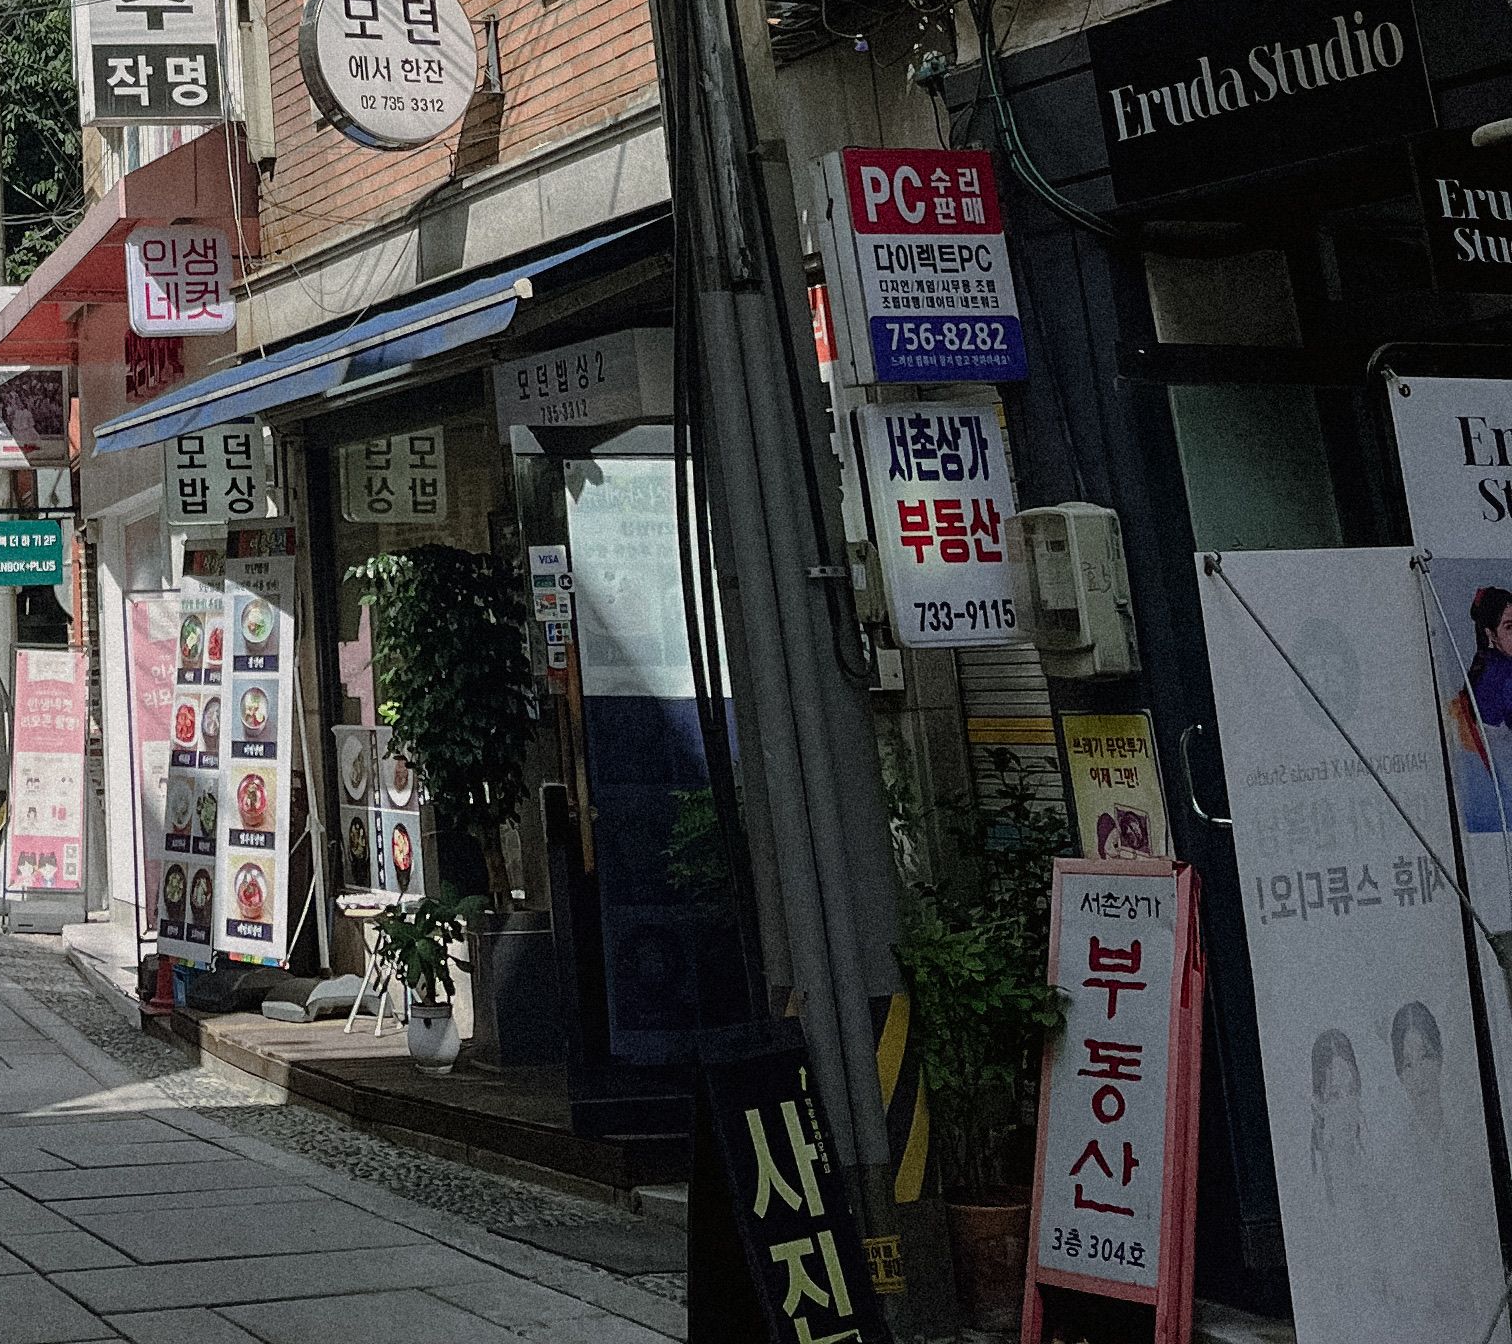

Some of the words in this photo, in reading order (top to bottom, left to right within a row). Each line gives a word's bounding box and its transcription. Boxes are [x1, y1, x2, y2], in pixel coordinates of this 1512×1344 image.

[106, 53, 210, 108] 작명
[348, 54, 392, 83] 에서
[400, 58, 444, 85] 한잔
[1108, 56, 1250, 142] Eruda
[1248, 10, 1405, 103] Studio
[360, 94, 377, 111] 02
[381, 95, 406, 112] 735
[410, 97, 445, 113] 3312
[861, 166, 925, 224] PC
[929, 168, 980, 194] 수리
[933, 196, 986, 226] 판매
[142, 238, 219, 279] 인생
[872, 243, 994, 275] 다이렉트PC
[144, 280, 223, 321] 네컷
[885, 322, 1008, 351] 756-8282
[176, 433, 253, 470] 모던
[887, 415, 990, 482] 서촌상가
[178, 475, 257, 515] 밥상
[896, 498, 1004, 565] 부동산
[914, 597, 1016, 633] 733-9115
[1105, 737, 1149, 759] 무단투기
[1080, 891, 1162, 920] 서촌상가
[1069, 935, 1148, 1217] 부동산
[1052, 1226, 1083, 1259] 3층
[1087, 1234, 1148, 1270] 304호
